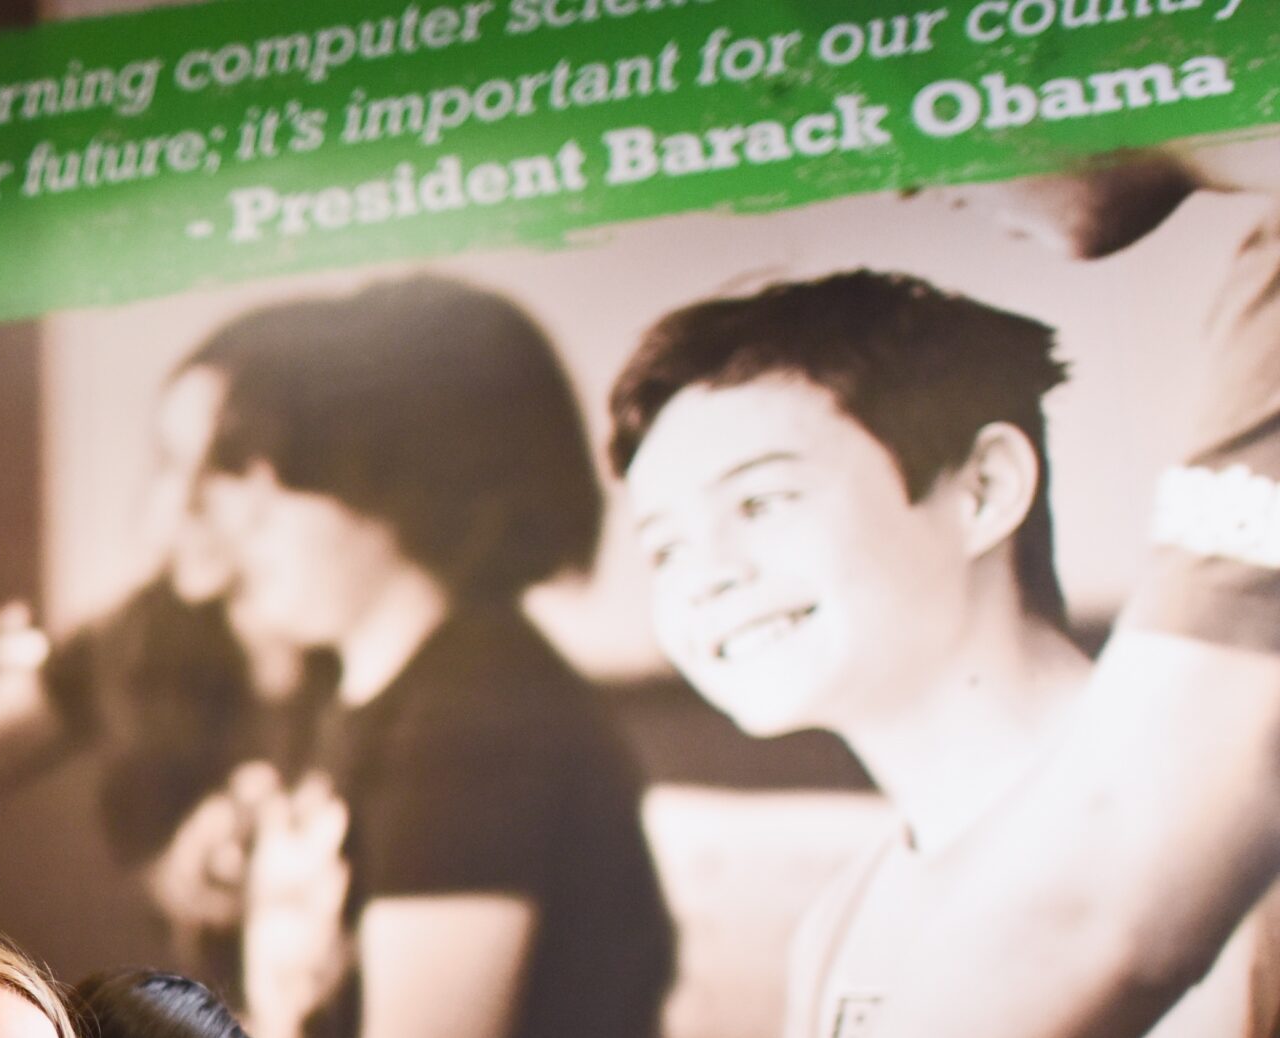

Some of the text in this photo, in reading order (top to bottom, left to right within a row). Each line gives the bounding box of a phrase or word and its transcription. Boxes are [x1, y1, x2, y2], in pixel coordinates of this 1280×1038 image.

[24, 125, 226, 196] future;
[236, 100, 327, 161] it’s
[341, 42, 680, 145] important
[699, 27, 803, 86] for
[819, 11, 948, 66] our
[175, 0, 494, 91] computer
[228, 141, 588, 242] President
[602, 95, 891, 185] Barack
[911, 55, 1235, 138] Obama
